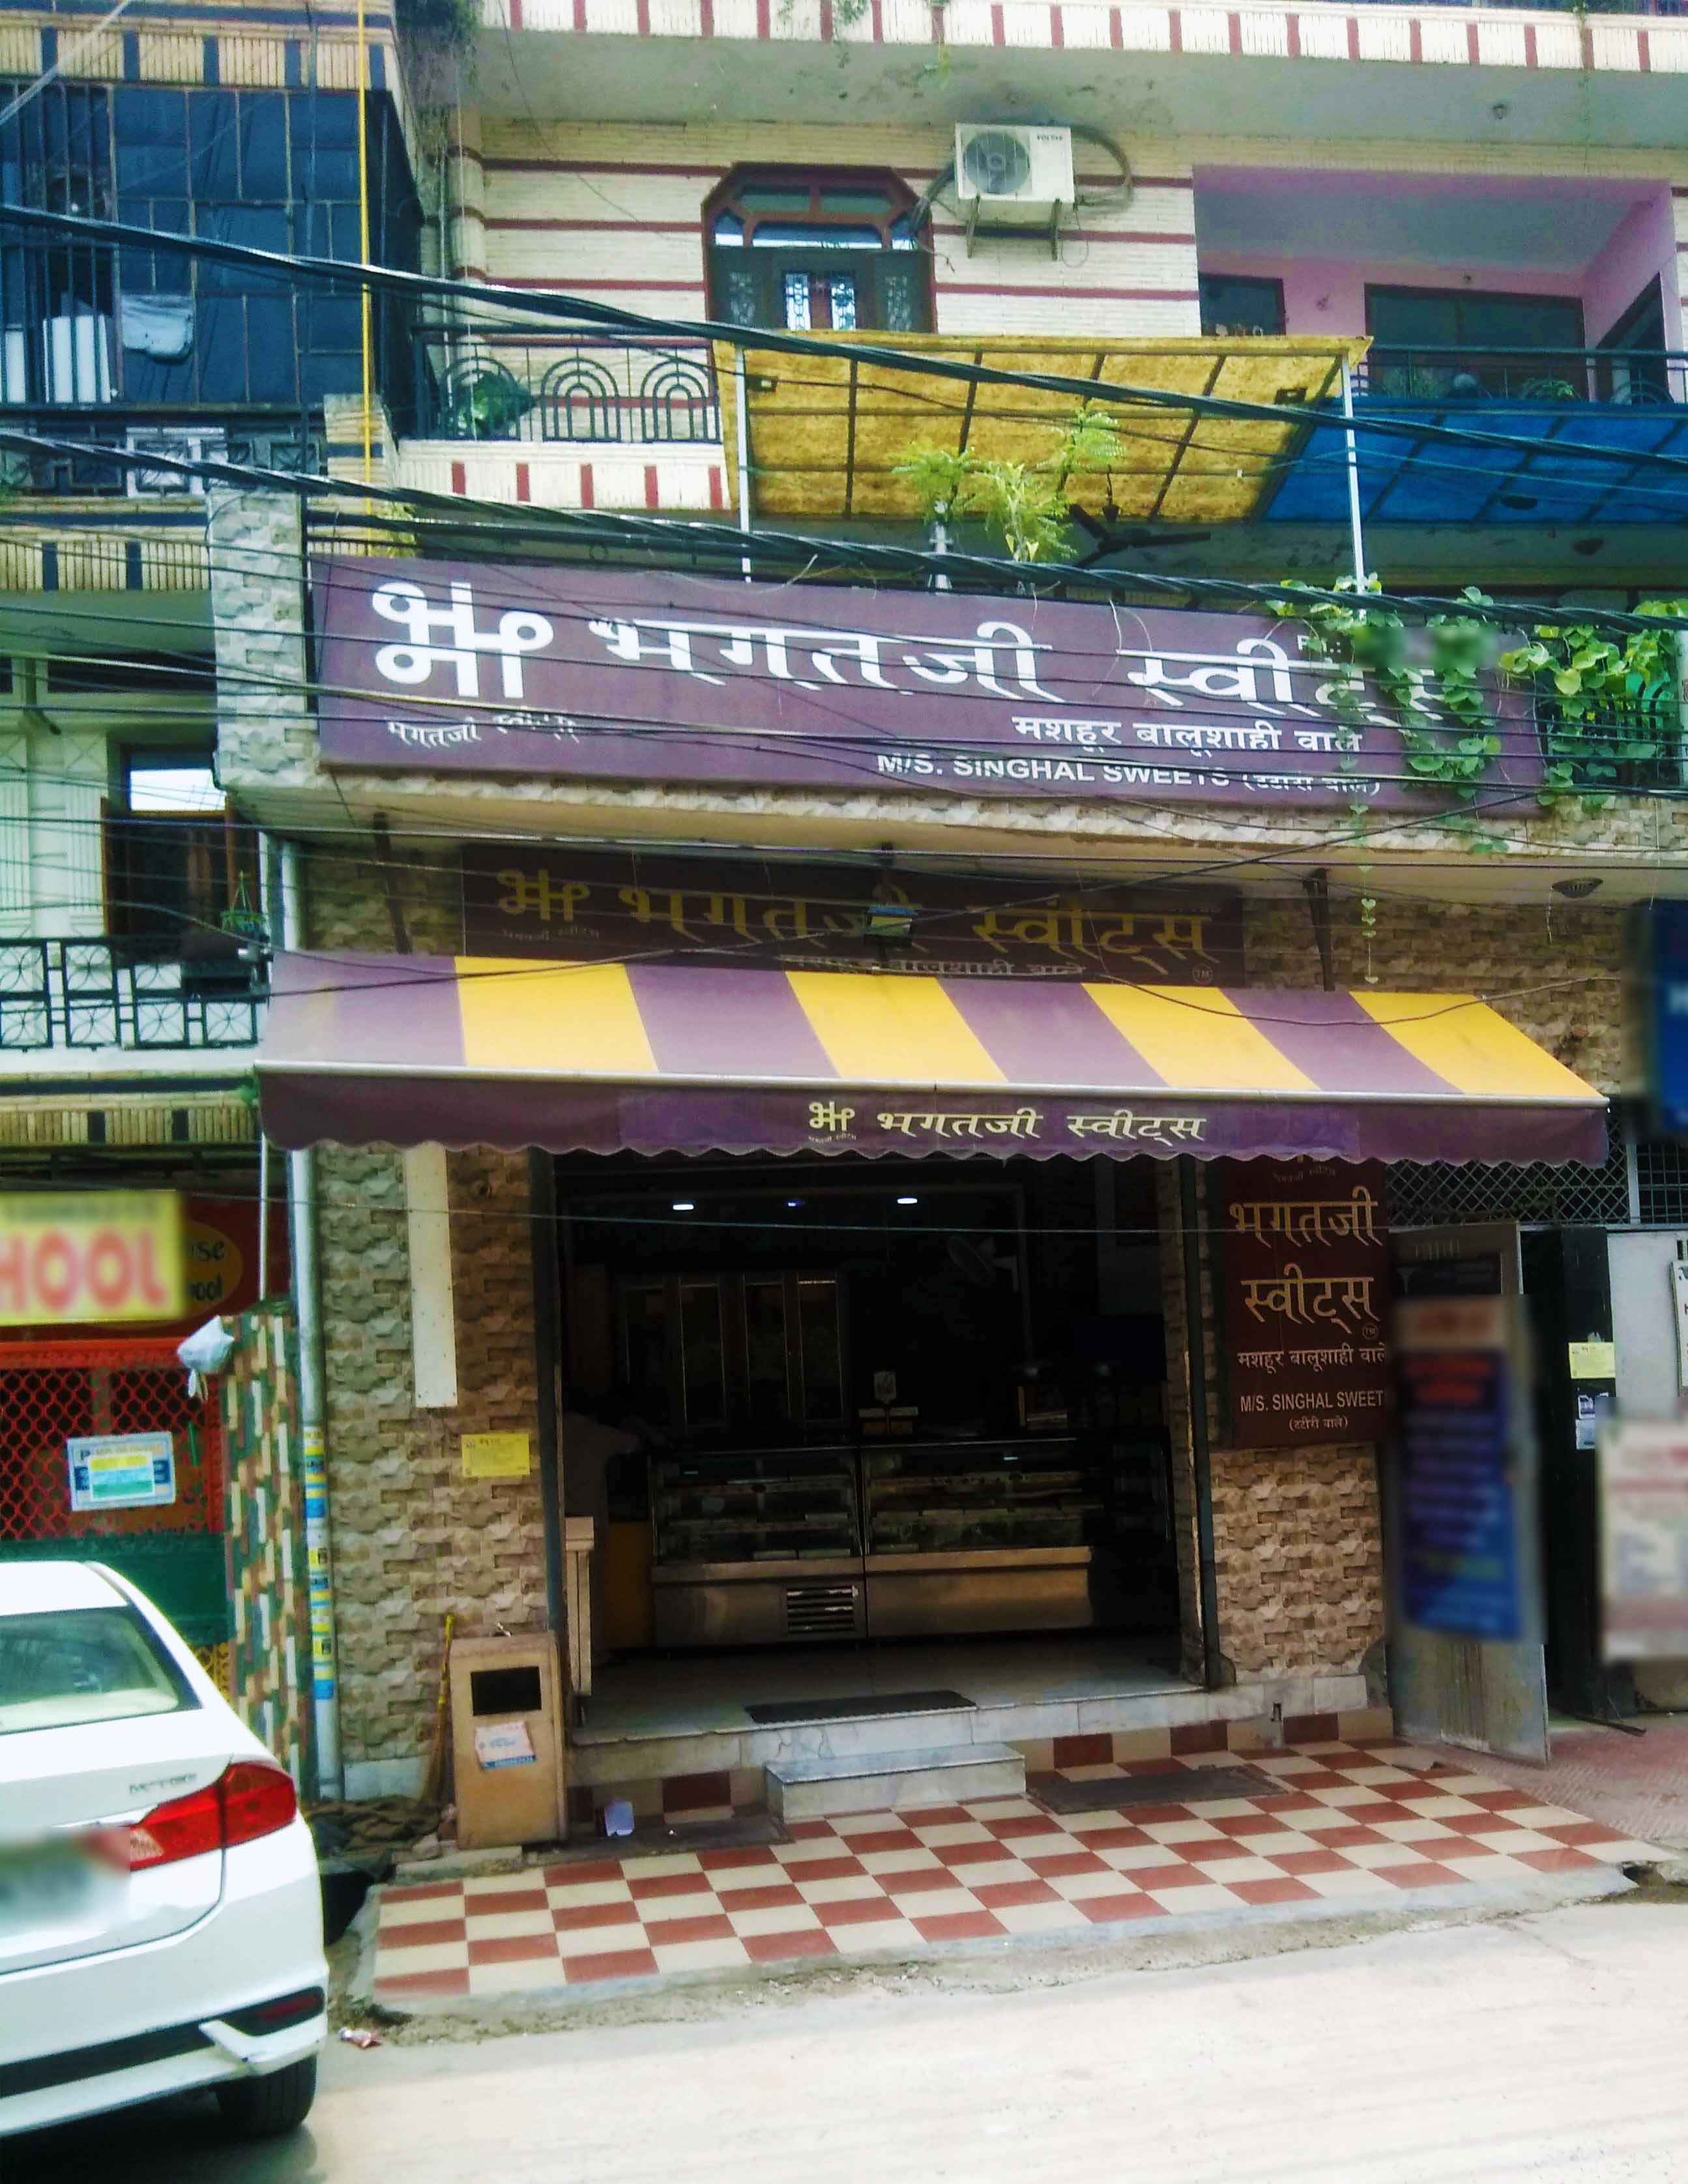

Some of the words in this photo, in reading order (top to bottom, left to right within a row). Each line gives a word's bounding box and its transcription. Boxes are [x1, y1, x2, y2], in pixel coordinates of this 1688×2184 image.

[588, 620, 1066, 704] भगतजी
[1011, 715, 1122, 753] मशहूर
[1132, 719, 1283, 758] बालूशाही
[877, 752, 944, 776] M/S.
[953, 755, 1096, 782] SINGHAL
[877, 1108, 1044, 1139] भगतजी
[1066, 1109, 1207, 1147] स्वीट्स
[1229, 1186, 1383, 1248] भगतजी
[1240, 1263, 1381, 1334] स्वीट्स
[1237, 1350, 1285, 1374] मशहूर
[1288, 1342, 1354, 1372] बालूशाही
[1240, 1396, 1269, 1413] M/S.
[1272, 1392, 1333, 1411] SINGHAL
